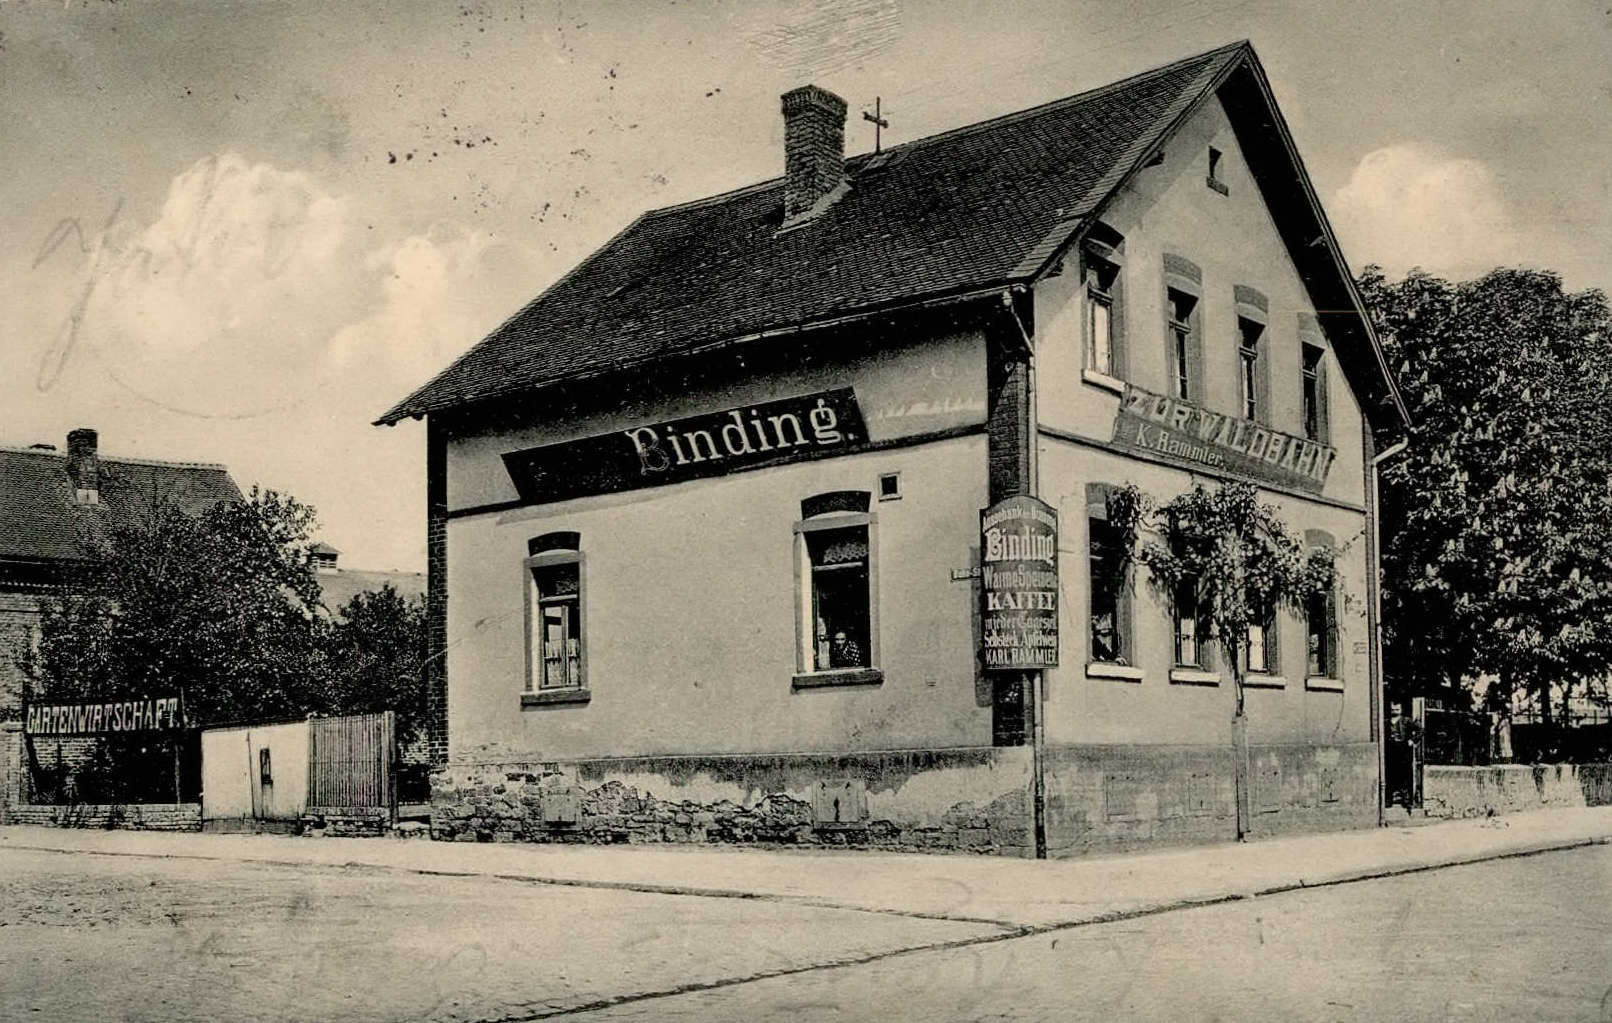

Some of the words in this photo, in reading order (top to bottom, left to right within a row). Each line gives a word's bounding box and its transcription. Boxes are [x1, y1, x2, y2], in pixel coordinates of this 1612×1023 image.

[1129, 388, 1193, 431] ZUR
[1199, 409, 1335, 484] WALDBAHN
[1136, 422, 1154, 448] K.
[984, 525, 1054, 567] Binding
[982, 565, 1017, 589] Warme
[987, 591, 1056, 611] KAFFEE
[985, 648, 1010, 665] KARL
